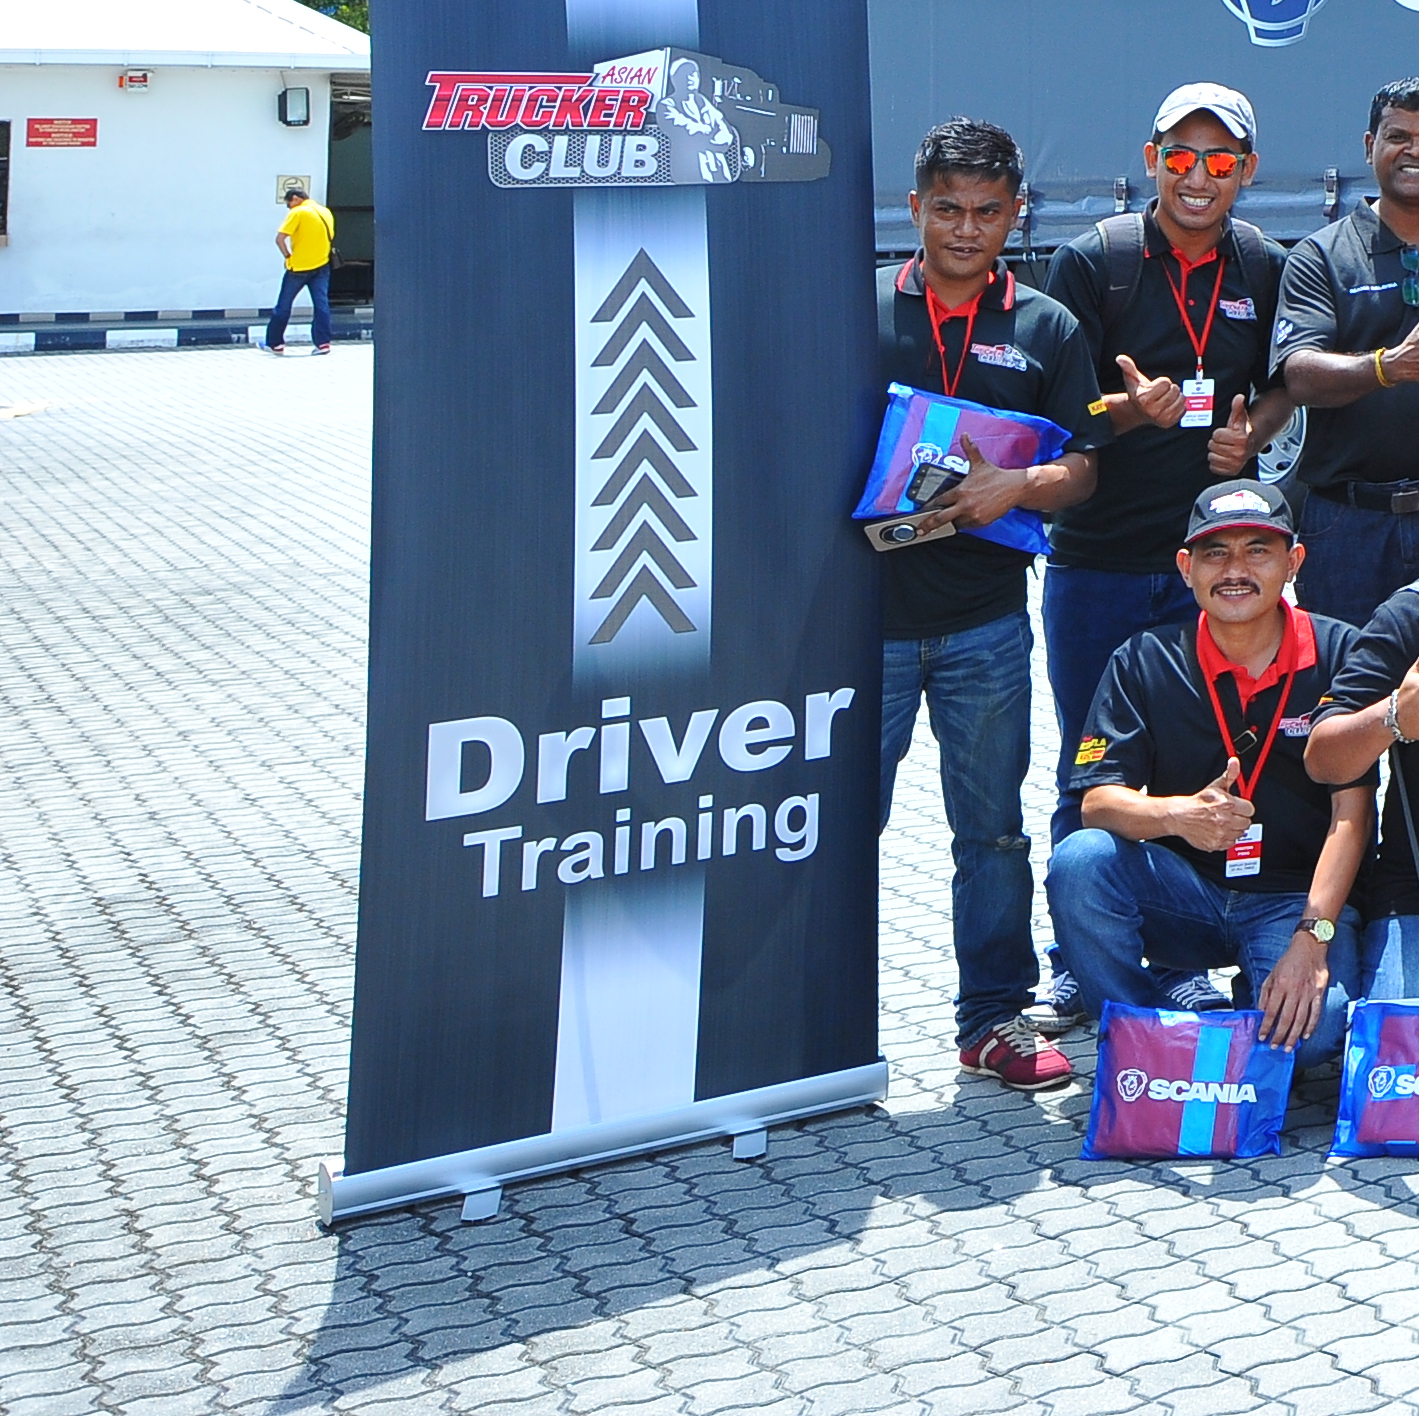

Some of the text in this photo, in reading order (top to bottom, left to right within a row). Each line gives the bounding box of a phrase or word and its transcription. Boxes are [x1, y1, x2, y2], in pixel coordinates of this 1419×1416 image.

[421, 70, 654, 131] TRUCKER
[600, 65, 659, 86] ASIAN
[503, 133, 660, 181] CLUB
[424, 686, 857, 823] Driver
[462, 791, 821, 899] Training
[1147, 1078, 1257, 1105] SCANIA
